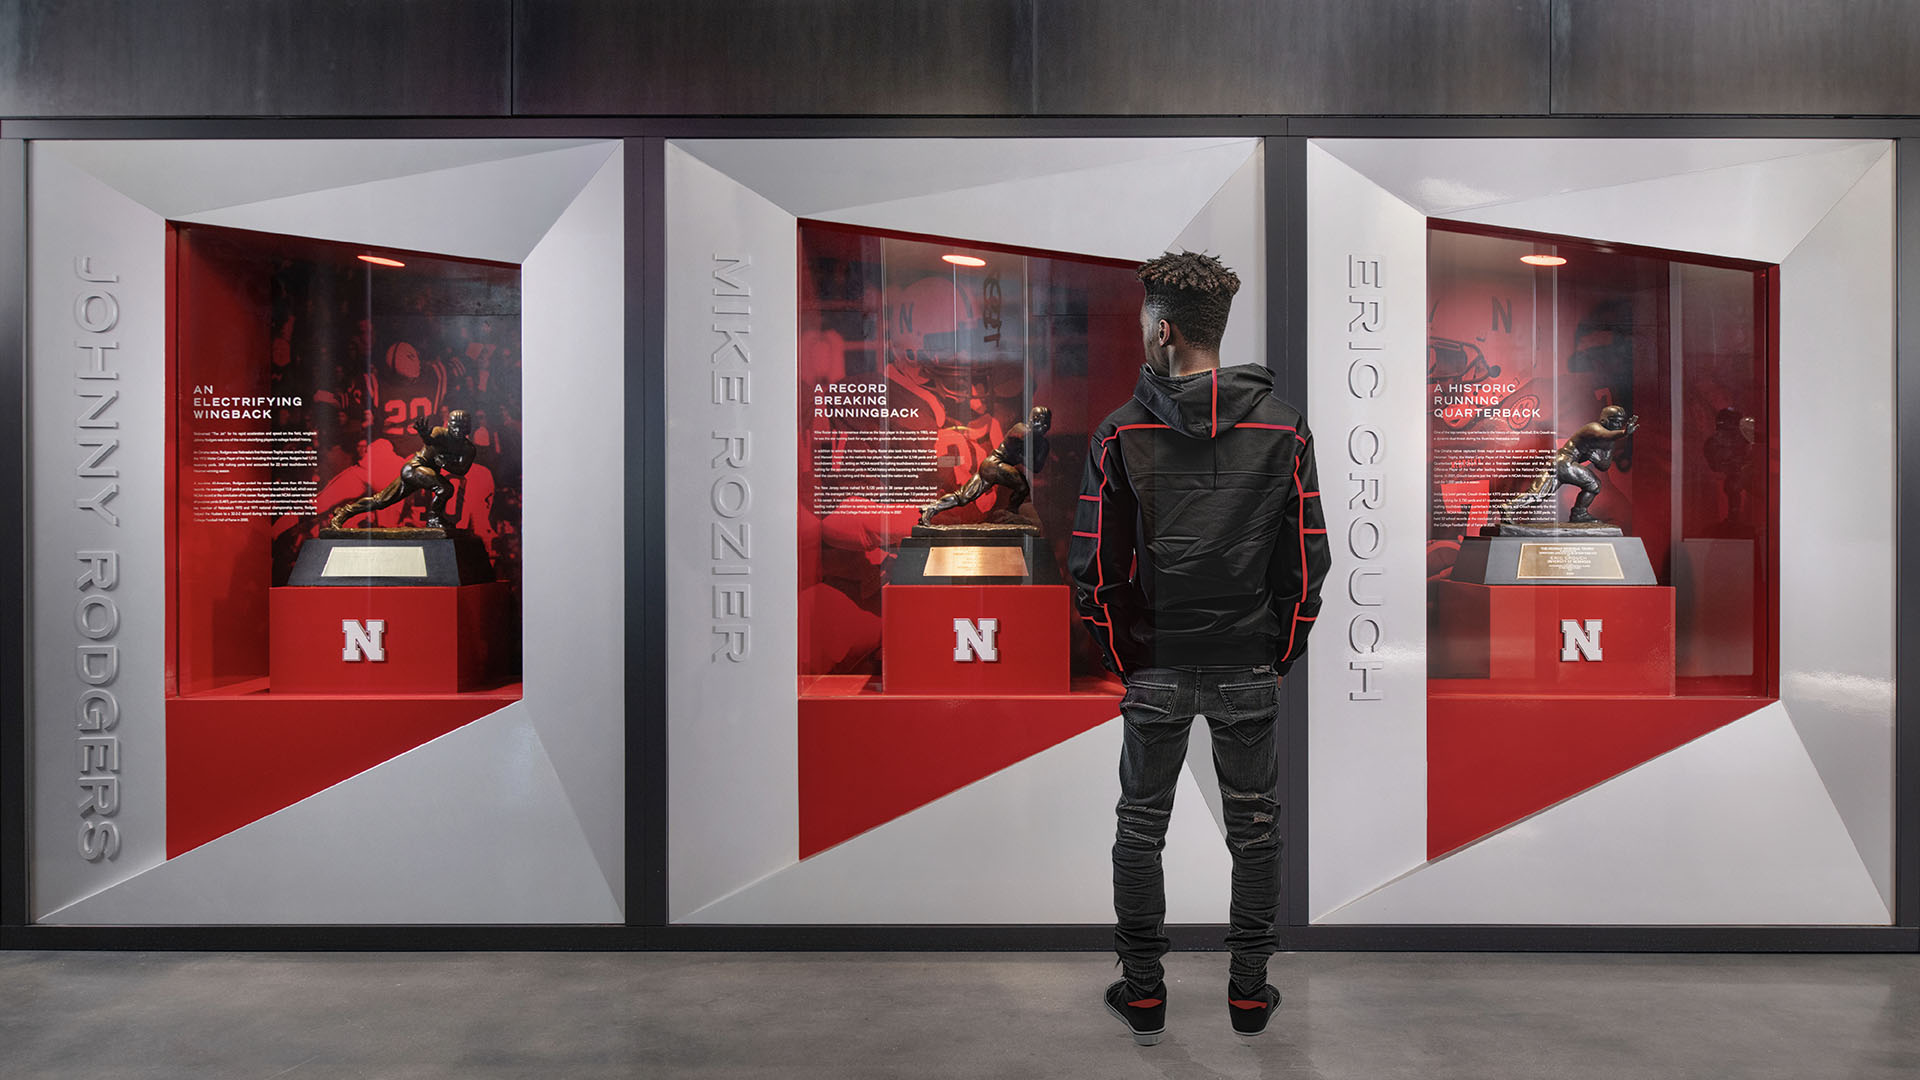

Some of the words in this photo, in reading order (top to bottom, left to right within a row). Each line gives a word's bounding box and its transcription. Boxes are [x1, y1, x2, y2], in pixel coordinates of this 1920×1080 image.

[711, 253, 752, 404] MIKE
[1348, 253, 1384, 399] ERIC
[74, 255, 120, 527] JOHNNY
[193, 385, 213, 395] AN
[814, 383, 823, 393] A
[829, 383, 887, 393] RECORD
[814, 396, 887, 406] BREAKING
[1433, 383, 1442, 393] A
[1449, 383, 1516, 393] HISTORIC
[1433, 396, 1499, 406] RUNNING
[193, 397, 302, 407] ELECTRIFYING
[193, 409, 272, 419] WINGBACK
[814, 408, 919, 418] RUNNINGBACK
[1433, 408, 1541, 418] QUARTERBACK
[711, 431, 752, 663] ROZIER
[1348, 423, 1384, 702] CROUCH
[342, 619, 385, 662] N
[953, 618, 998, 662] N
[1561, 619, 1603, 662] N
[75, 550, 121, 862] RODGERS
